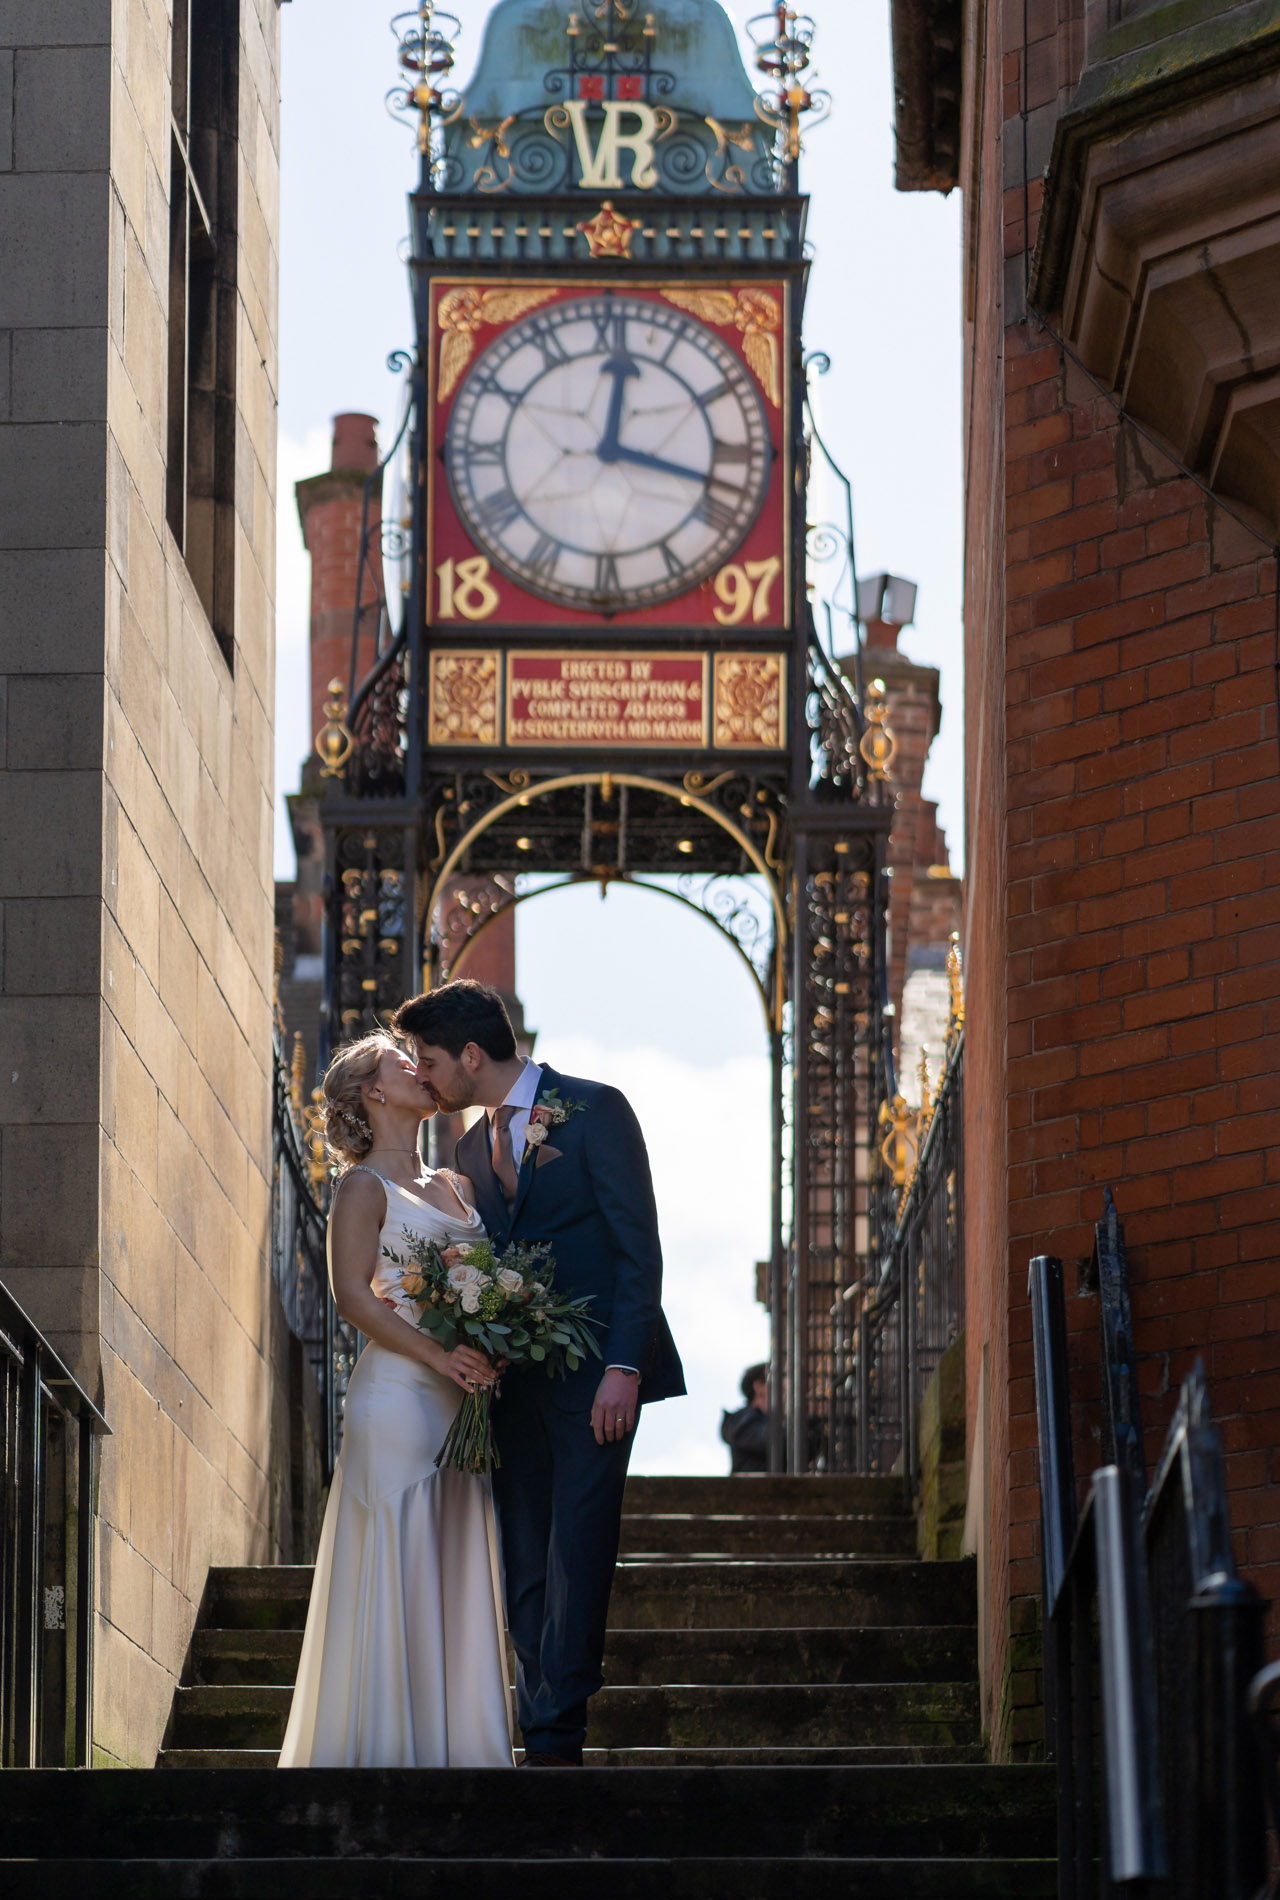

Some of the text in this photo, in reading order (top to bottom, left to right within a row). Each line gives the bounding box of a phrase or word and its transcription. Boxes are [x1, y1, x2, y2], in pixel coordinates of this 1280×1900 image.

[564, 100, 659, 190] VR
[436, 555, 499, 621] 18
[712, 556, 781, 625] 97
[560, 661, 652, 680] ERECTED BY
[686, 681, 701, 700] &
[528, 700, 621, 719] COMPLETED
[652, 720, 701, 738] MAYOR
